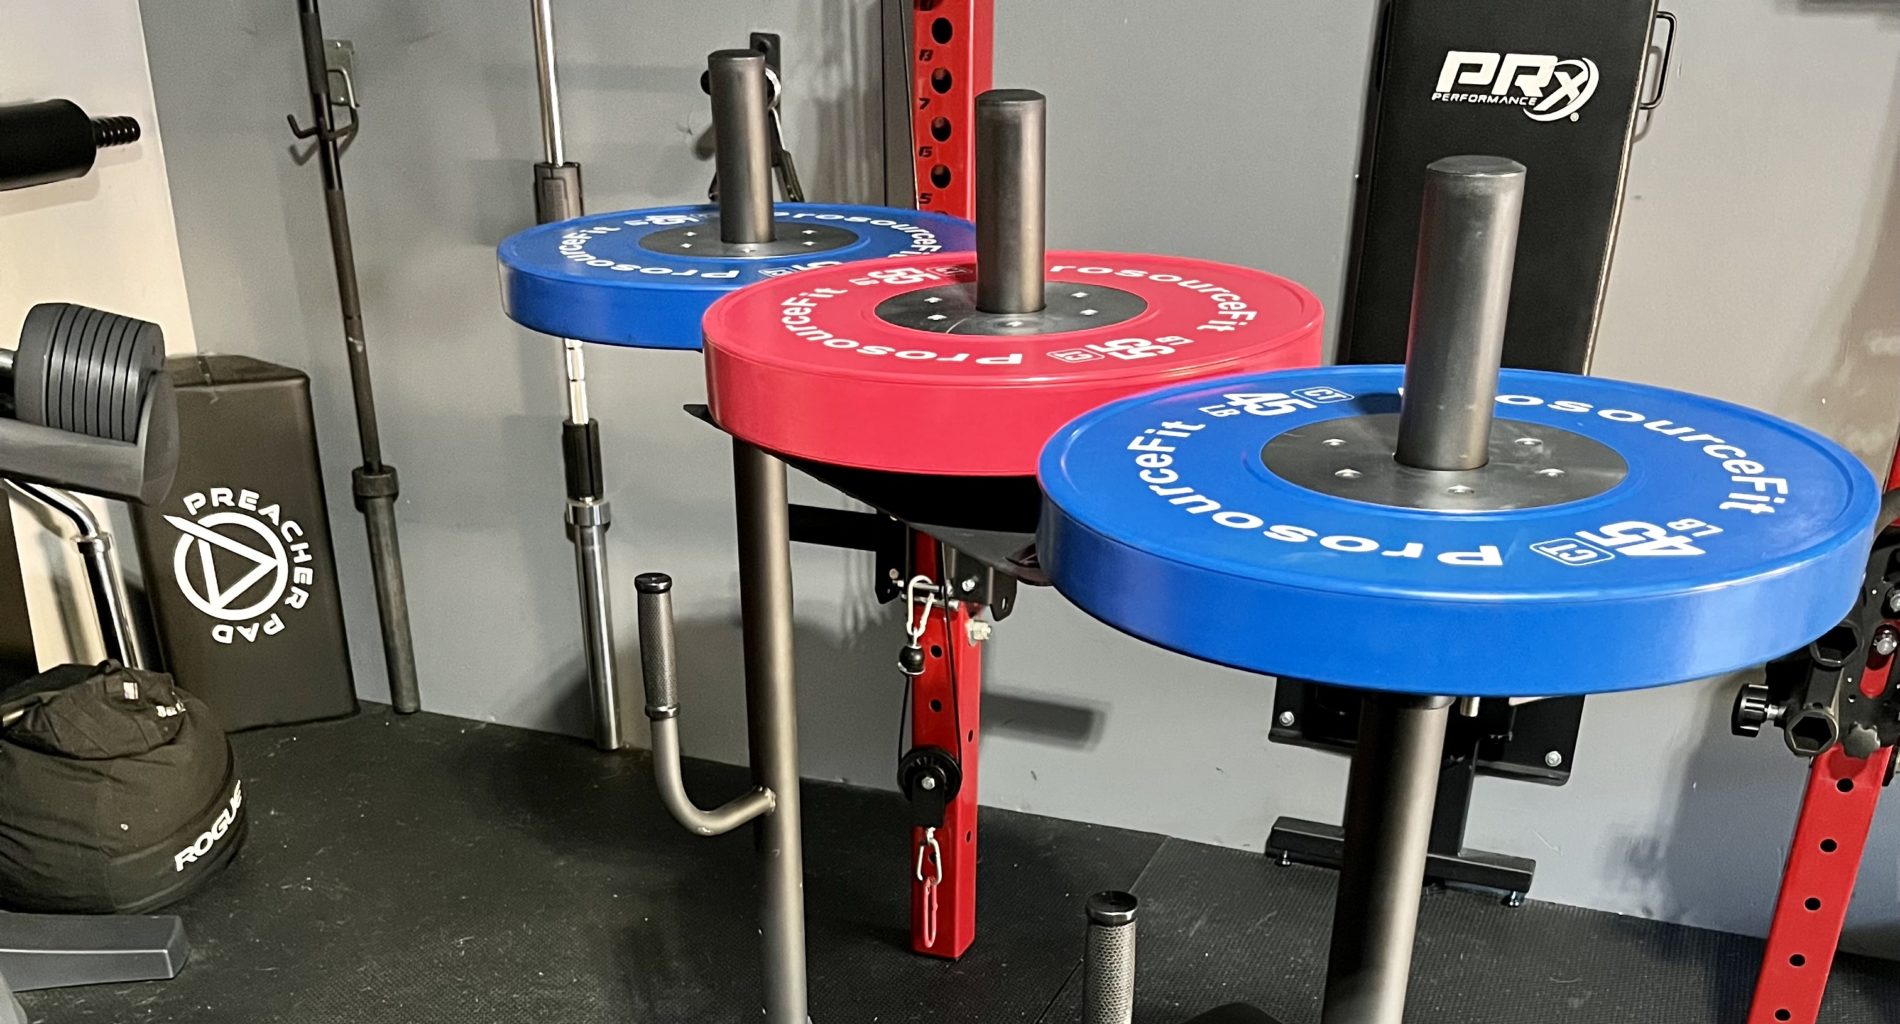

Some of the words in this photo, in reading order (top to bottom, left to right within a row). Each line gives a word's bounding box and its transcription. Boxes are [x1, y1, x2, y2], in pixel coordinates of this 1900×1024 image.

[918, 97, 931, 110] 7
[1431, 91, 1538, 107] PERFORMANCE
[1049, 265, 1258, 332] rosourceFit
[780, 286, 1023, 365] ProsourceFit
[1084, 337, 1176, 361] 55
[1197, 404, 1241, 418] LB
[1222, 391, 1319, 417] 45
[1303, 387, 1345, 401] CT
[1494, 394, 1789, 516] osourceFit
[1126, 420, 1504, 567] ProsourceFit
[1576, 520, 1707, 556] 45
[1665, 518, 1724, 538] LB
[182, 486, 314, 610] PREACHER
[1539, 540, 1600, 564] CT
[211, 612, 286, 645] PAD
[174, 779, 243, 872] ROGUE
